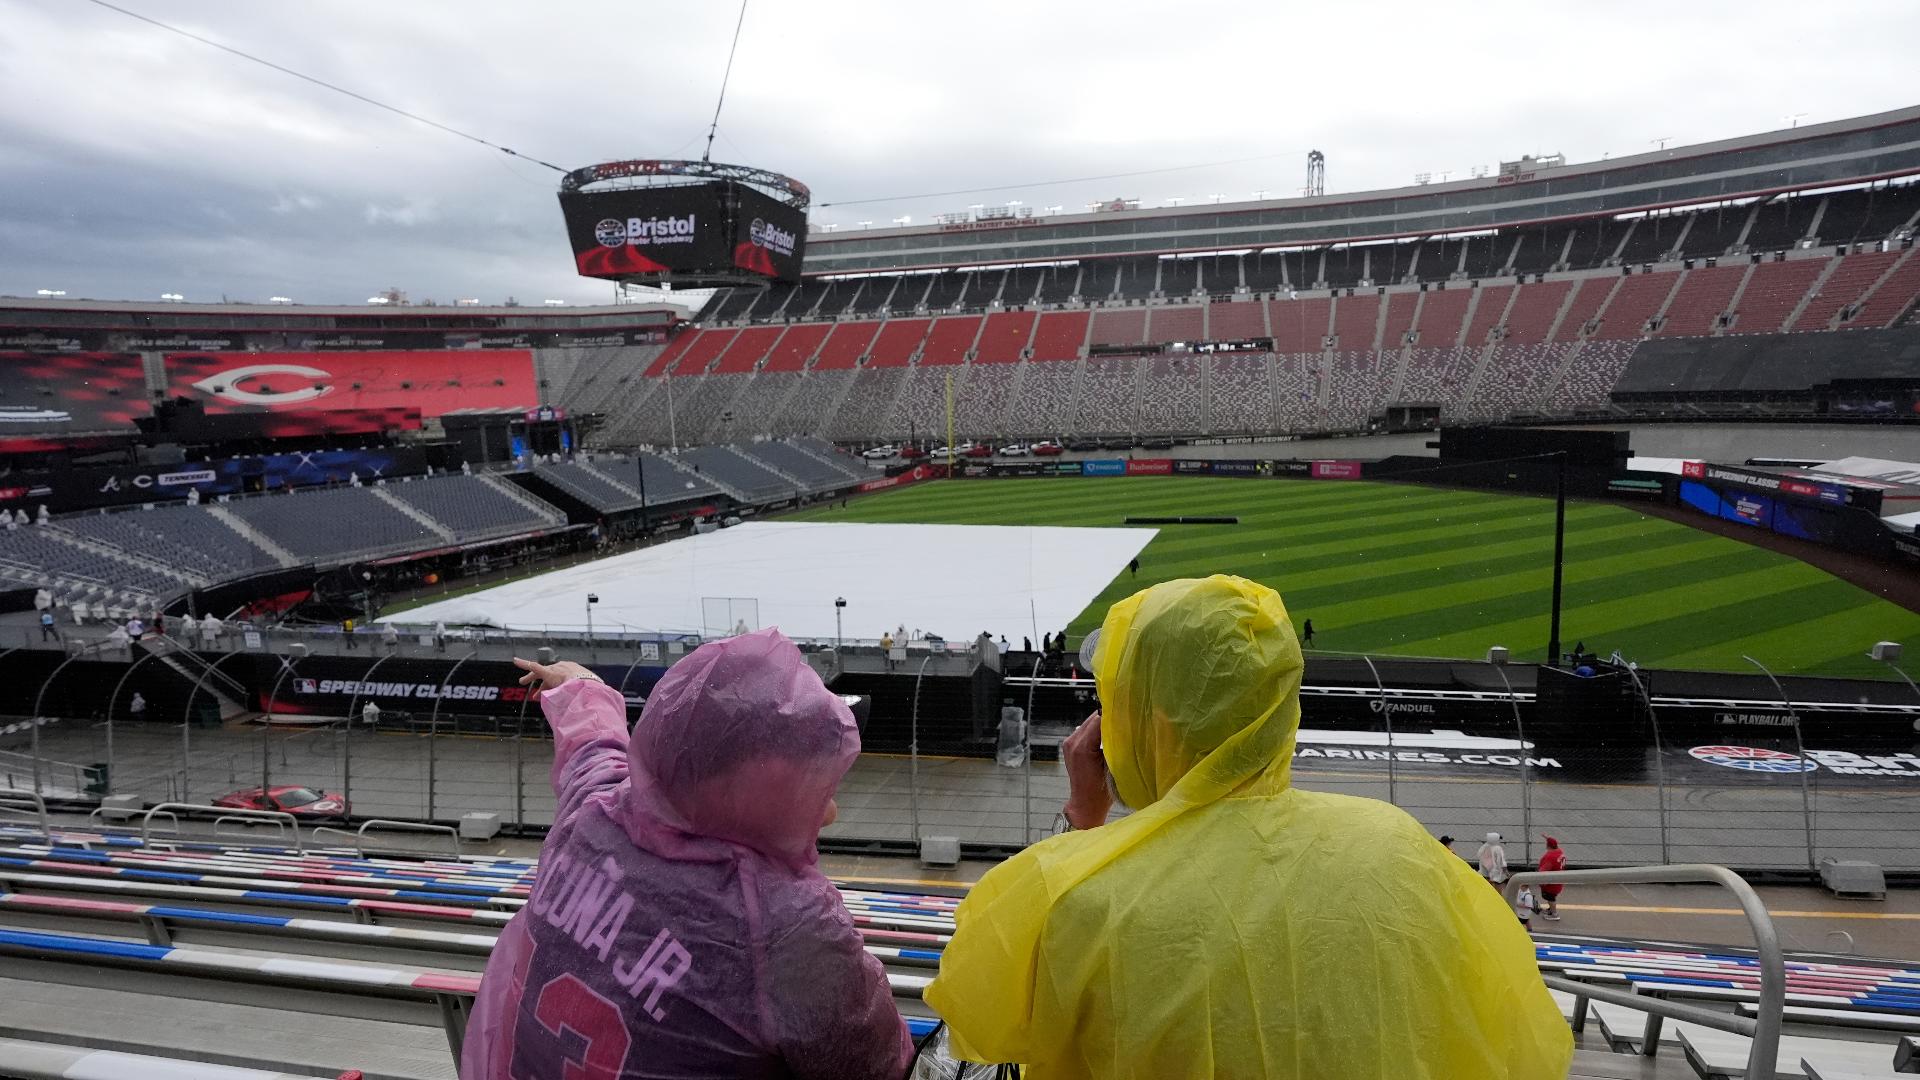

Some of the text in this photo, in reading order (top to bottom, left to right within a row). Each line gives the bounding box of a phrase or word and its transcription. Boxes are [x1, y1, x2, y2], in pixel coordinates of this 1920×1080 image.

[627, 214, 695, 237] Bristol
[627, 235, 694, 246] Motor Speedway
[766, 223, 796, 250] Bristol
[1714, 470, 1748, 484] SPEEDWAY
[1747, 476, 1780, 489] CLASSIC
[319, 680, 416, 697] SPEEDWAY
[415, 684, 499, 700] CLASSIC
[1386, 703, 1435, 714] FANDUEL
[1292, 748, 1563, 768] ARINES.COM
[531, 850, 692, 1023] CUÑA JR.
